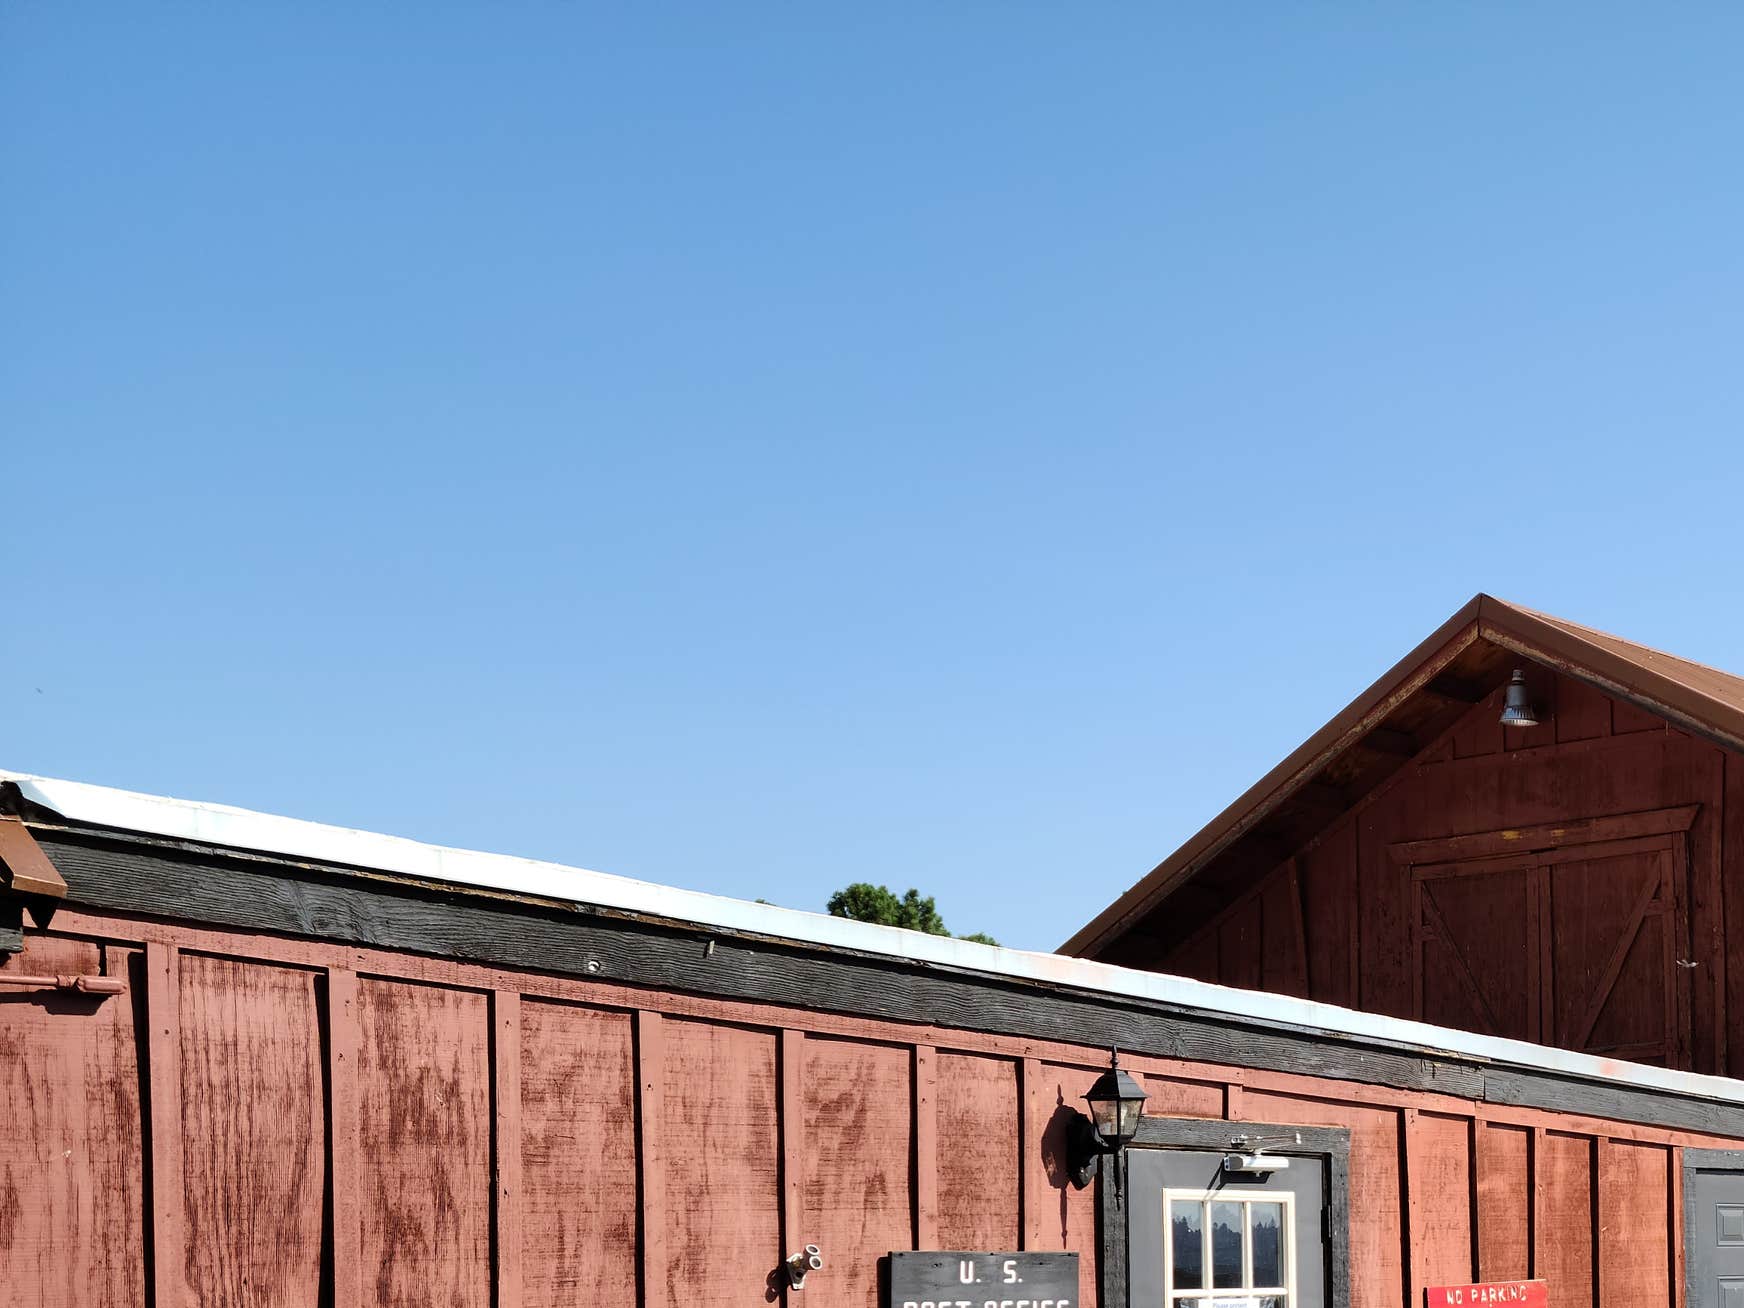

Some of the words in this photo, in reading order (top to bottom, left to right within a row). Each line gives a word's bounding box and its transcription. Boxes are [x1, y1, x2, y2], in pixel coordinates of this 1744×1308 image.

[959, 1260, 982, 1285] U.
[1002, 1260, 1024, 1285] S.
[1446, 1289, 1463, 1306] NO
[1471, 1284, 1528, 1303] PARKING
